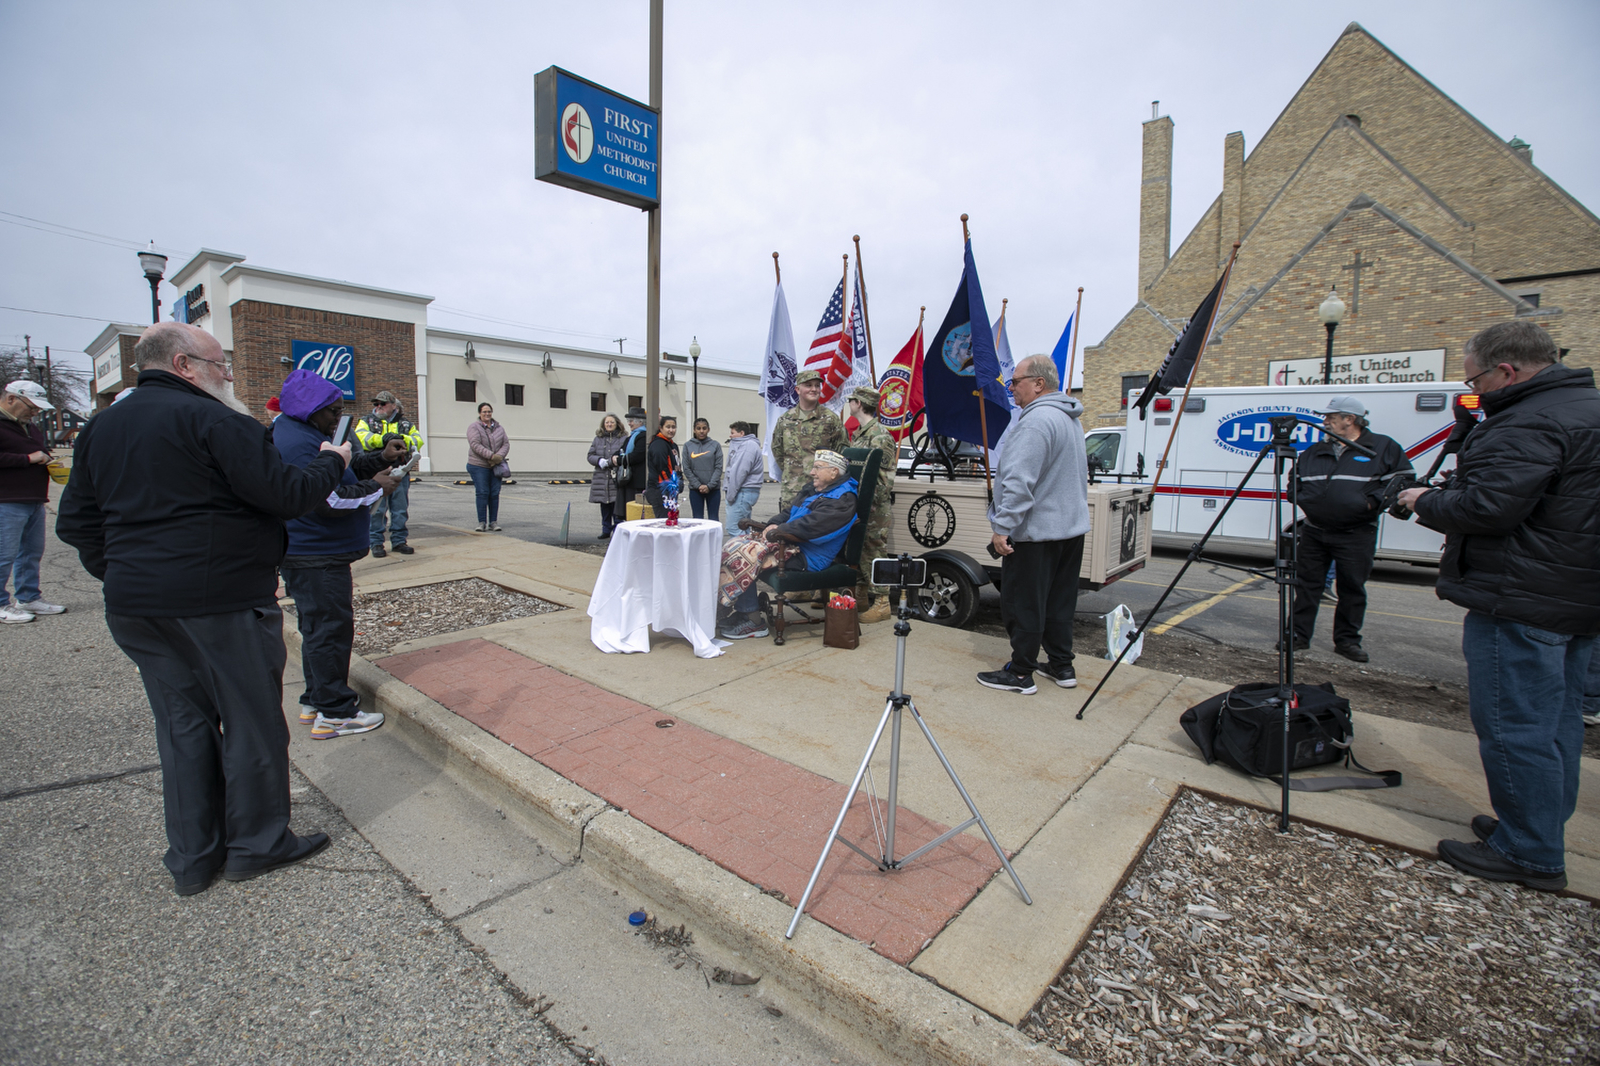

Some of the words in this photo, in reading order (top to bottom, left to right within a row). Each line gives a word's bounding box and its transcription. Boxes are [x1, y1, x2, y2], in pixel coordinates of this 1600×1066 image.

[604, 107, 652, 139] FIRST
[606, 130, 648, 153] UNITED
[597, 144, 657, 172] METHODIST
[603, 163, 647, 185] CHURCH
[297, 346, 352, 382] CNB
[886, 369, 909, 379] STATES
[1359, 356, 1411, 371] United
[1376, 369, 1435, 384] Church
[1218, 407, 1254, 424] JACKSON
[1226, 422, 1325, 443] J-DRT
[918, 497, 948, 509] NATIONAL
[946, 508, 954, 534] GUARD
